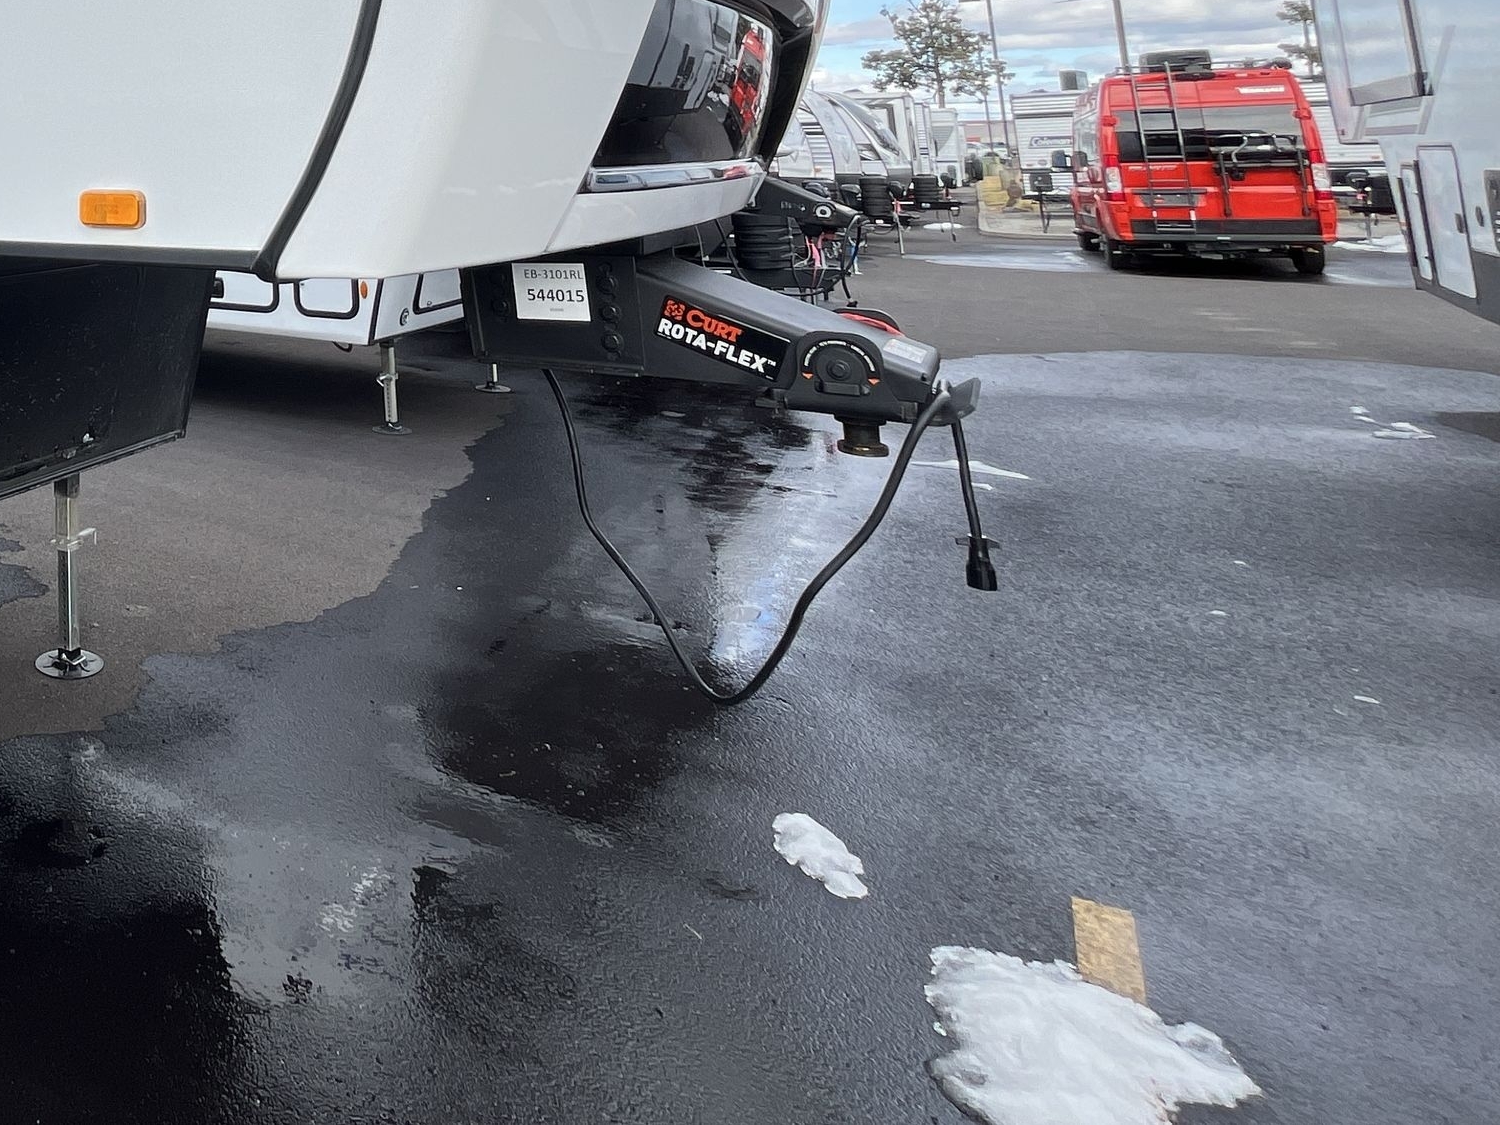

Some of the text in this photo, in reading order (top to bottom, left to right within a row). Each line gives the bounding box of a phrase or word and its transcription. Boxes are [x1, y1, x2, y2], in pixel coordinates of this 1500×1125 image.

[523, 268, 584, 280] EB-3101RL
[527, 288, 585, 303] 544015
[686, 309, 743, 342] CURT
